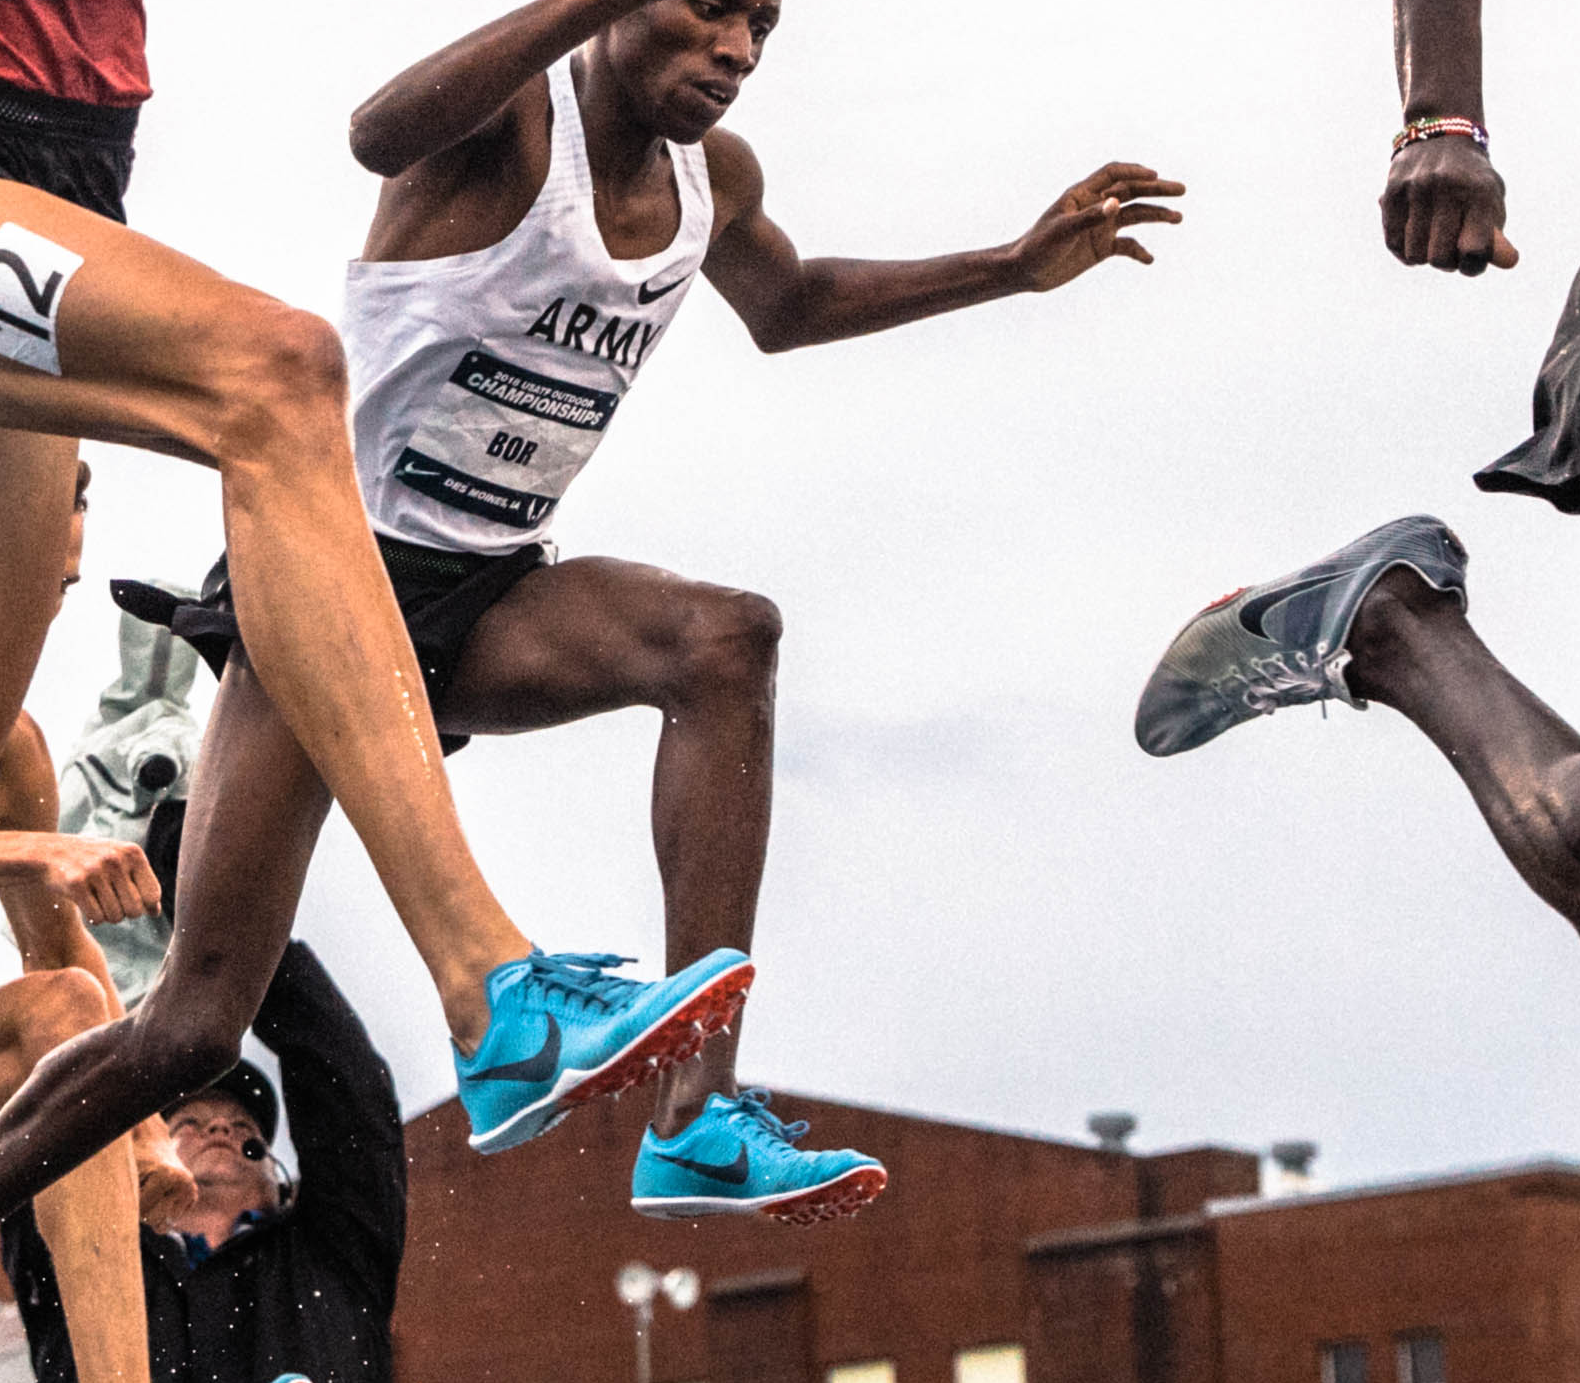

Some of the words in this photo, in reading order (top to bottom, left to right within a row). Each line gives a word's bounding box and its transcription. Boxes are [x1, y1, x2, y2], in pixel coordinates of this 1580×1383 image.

[525, 297, 662, 367] ARMY
[467, 373, 604, 426] CHAMPIONSHIPS
[493, 371, 521, 387] 2018
[521, 380, 552, 396] USATF
[551, 390, 595, 408] OUTDOOR
[486, 431, 538, 466] BOR
[444, 478, 469, 494] DES
